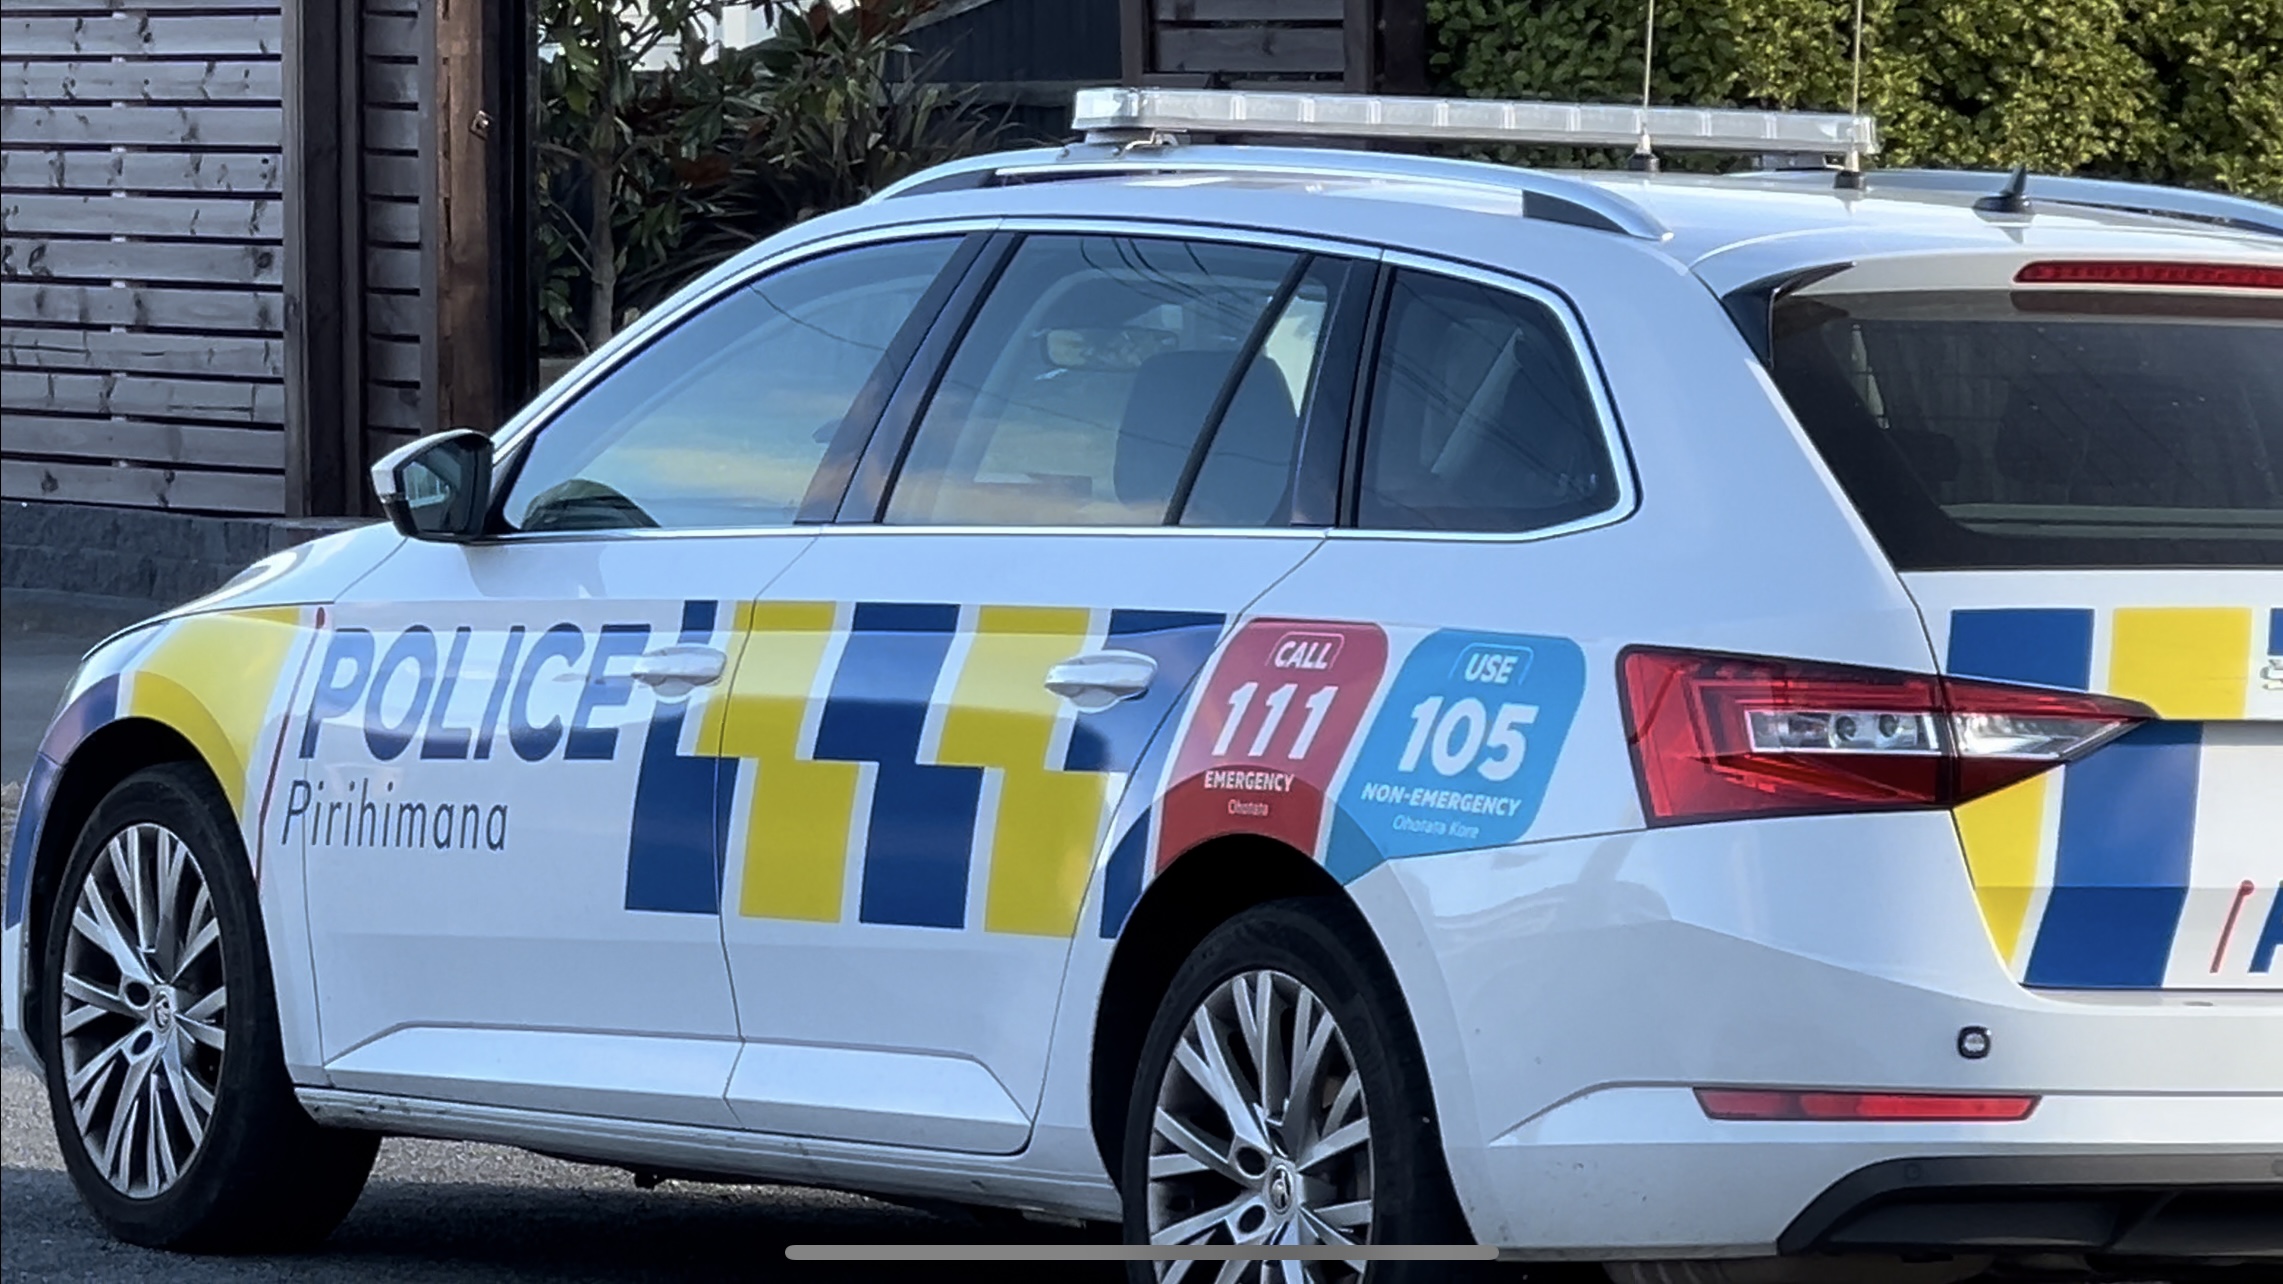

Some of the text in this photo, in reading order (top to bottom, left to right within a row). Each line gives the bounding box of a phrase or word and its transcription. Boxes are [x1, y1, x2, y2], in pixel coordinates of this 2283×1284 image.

[1273, 640, 1333, 669] CALL
[1464, 652, 1520, 684] USE
[299, 622, 652, 762] POLICE
[1211, 681, 1340, 760] 111
[1397, 695, 1540, 782] 105
[1204, 770, 1296, 793] EMERGENCY
[1360, 781, 1523, 817] NON-EMERGENCY
[280, 777, 509, 851] Pirihimana
[1449, 820, 1481, 840] Kore
